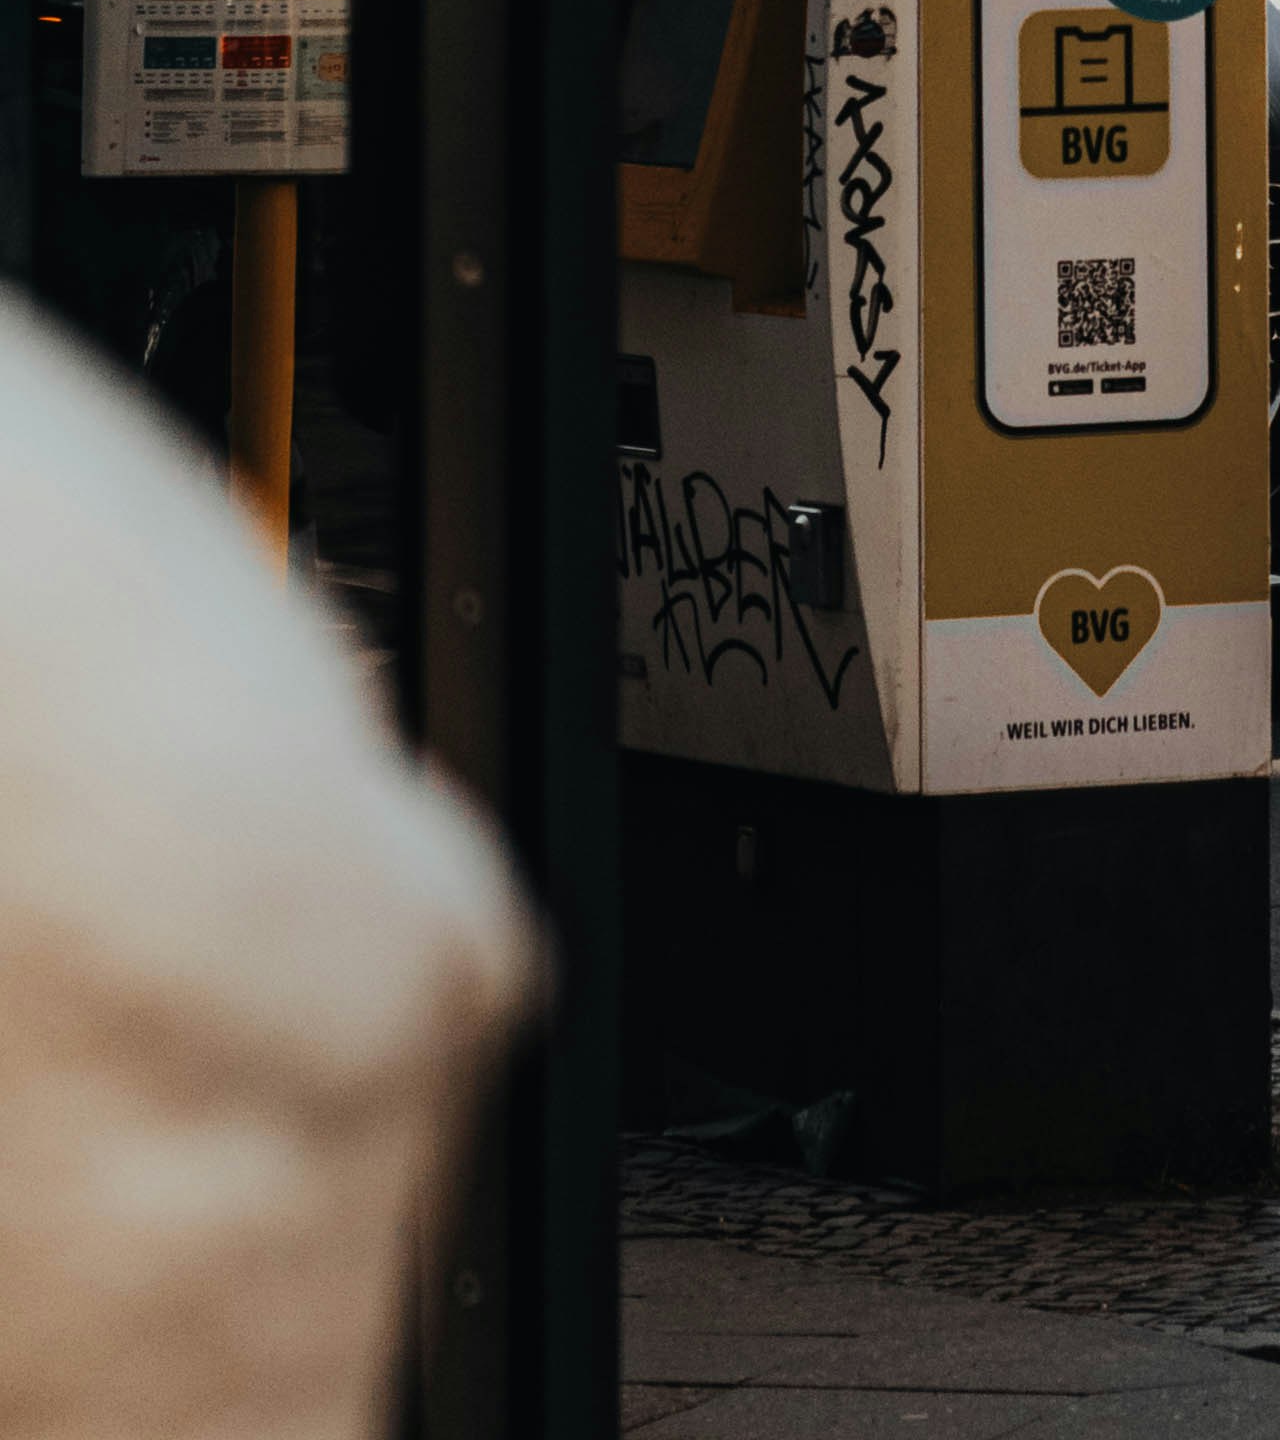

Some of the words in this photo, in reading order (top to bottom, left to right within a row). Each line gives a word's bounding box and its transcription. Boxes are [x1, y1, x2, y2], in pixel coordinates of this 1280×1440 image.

[1061, 125, 1128, 165] BVG
[1048, 360, 1146, 375] BVG.de/Ticket-App
[1071, 608, 1130, 644] BVG
[1006, 720, 1048, 740] WEIL
[1050, 718, 1085, 737] WIR
[1088, 715, 1128, 735] DICH
[1132, 711, 1196, 733] LIEBEN.
